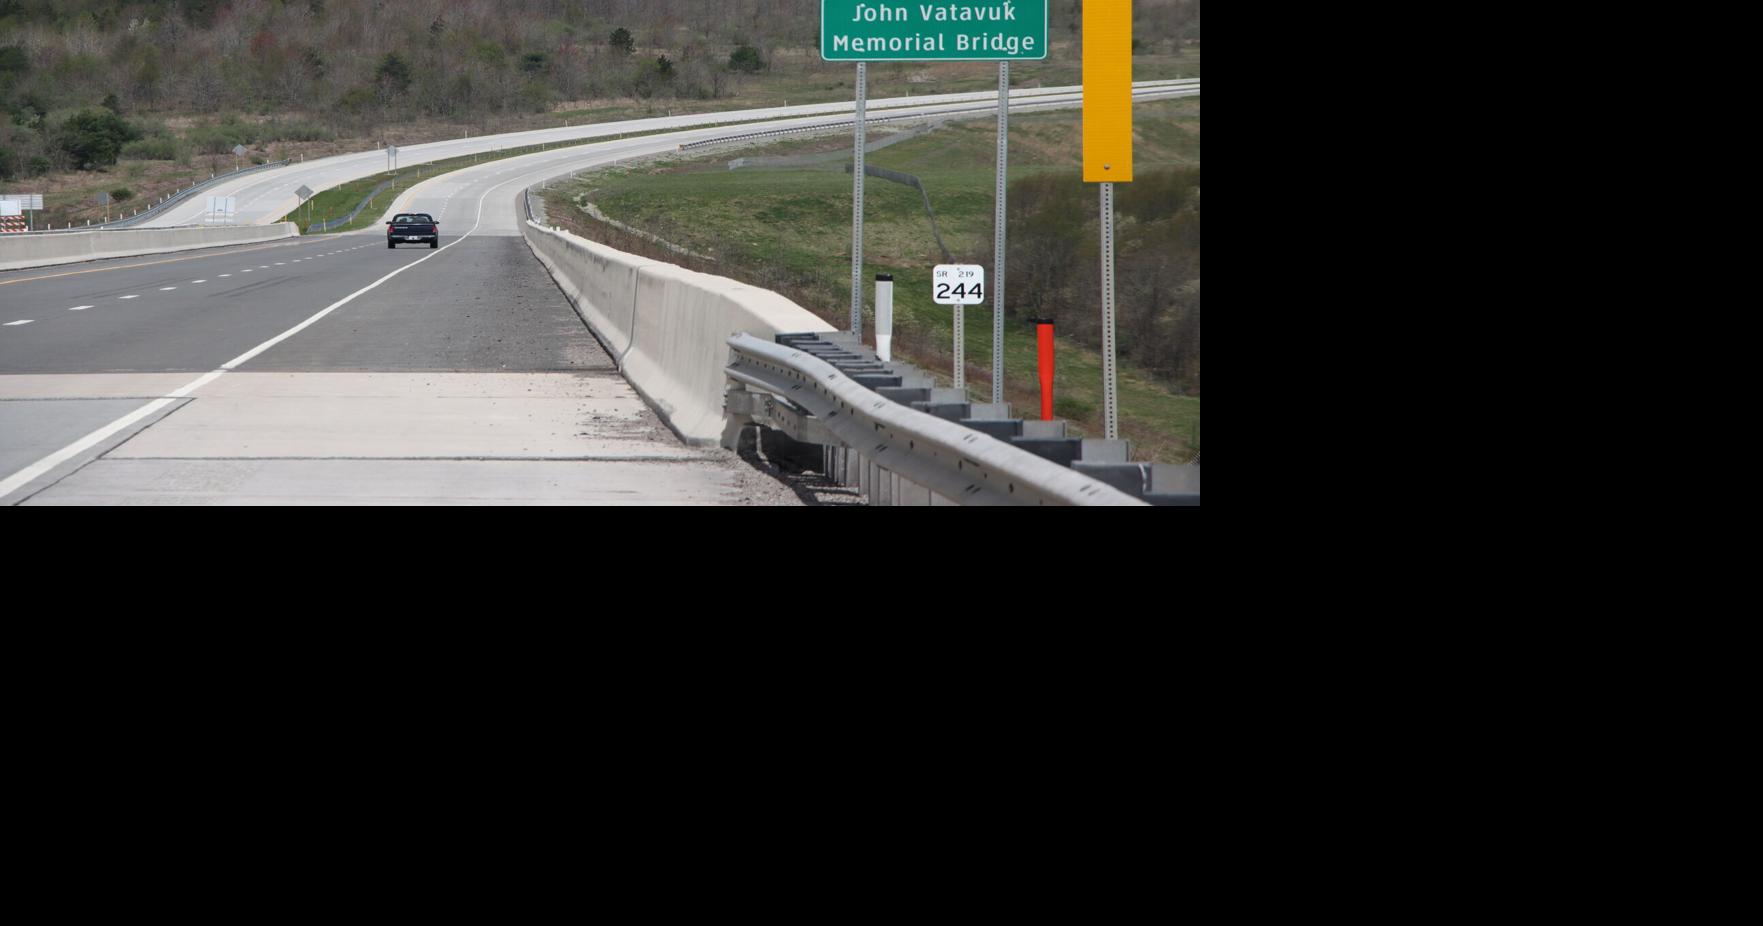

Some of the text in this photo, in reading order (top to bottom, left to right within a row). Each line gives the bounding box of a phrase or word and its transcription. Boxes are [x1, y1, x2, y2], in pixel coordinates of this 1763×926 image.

[852, 3, 1016, 22] John Vatavuk
[833, 33, 1035, 55] Memorial Bridge
[936, 282, 983, 299] 244
